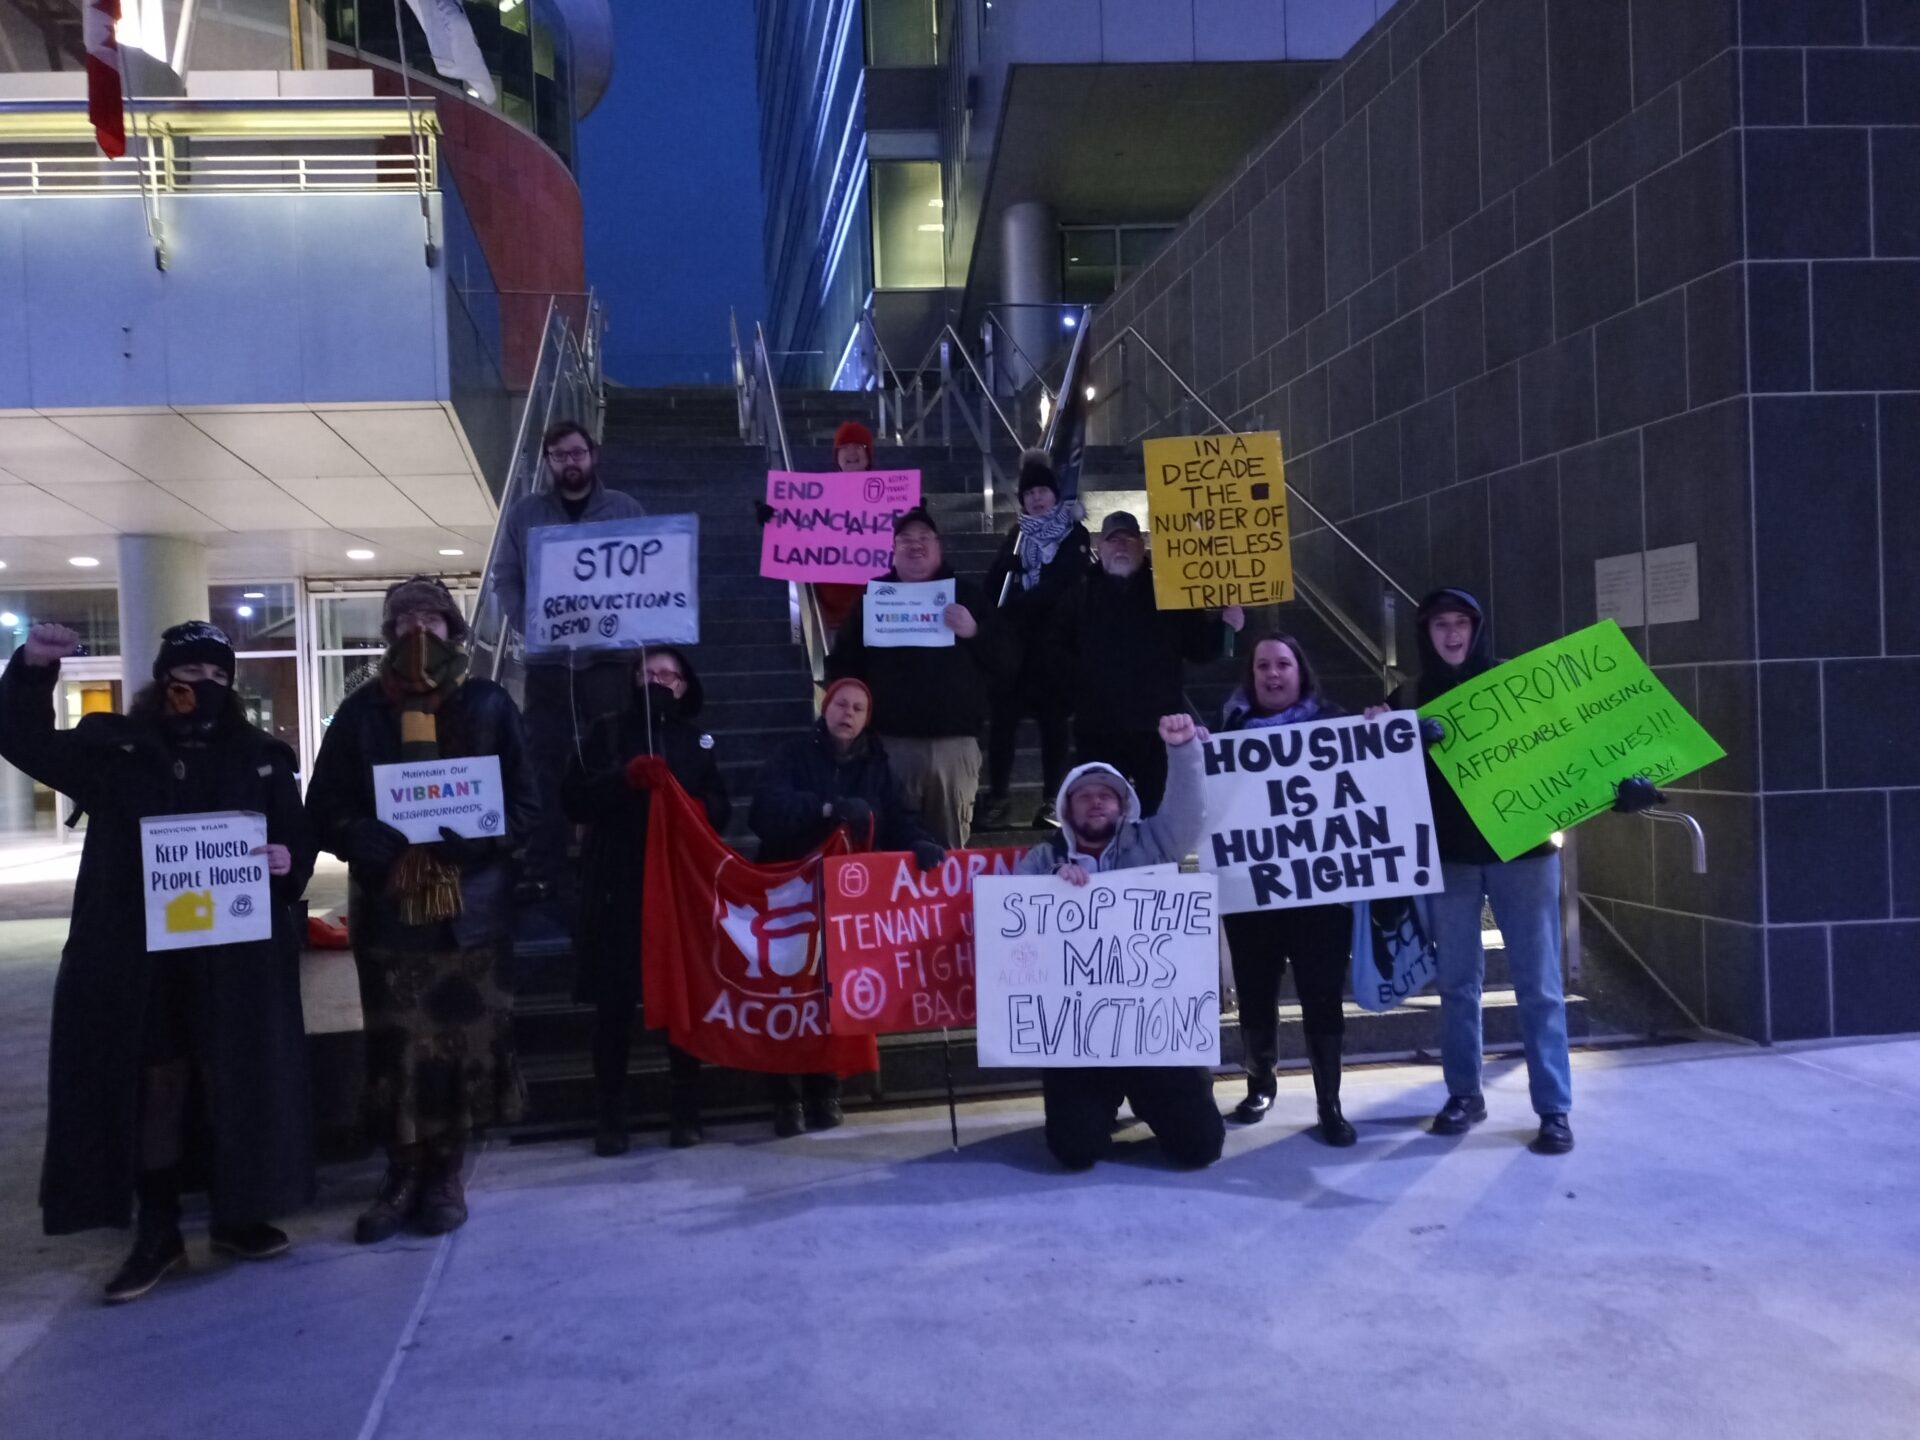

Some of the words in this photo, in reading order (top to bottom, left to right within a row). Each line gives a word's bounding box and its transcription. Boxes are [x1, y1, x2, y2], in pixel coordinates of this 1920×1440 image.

[1194, 437, 1221, 457] IN
[1231, 437, 1247, 455] A
[1162, 457, 1266, 486] DECADE
[773, 480, 824, 500] END
[1180, 483, 1242, 509] THE
[1155, 508, 1248, 535] NUMBER
[1254, 505, 1285, 527] OF
[1167, 531, 1283, 558] HOMELESS
[574, 539, 663, 581] STOP
[1182, 558, 1266, 580] COULD
[543, 591, 687, 619] RENOVICTIONS
[1180, 580, 1285, 609] TRIPLE!!!
[551, 616, 591, 641] DEMO
[875, 613, 939, 622] VIBRANT
[1427, 644, 1617, 754] DESTROYING
[1202, 718, 1416, 776] HOUSING
[1455, 717, 1575, 788] AFFORDABLE
[1577, 679, 1653, 724] HOUSING
[402, 768, 446, 780] Maintain
[450, 766, 468, 776] Our
[1491, 762, 1588, 823] RUINS
[1590, 708, 1679, 768] LIVES!!!
[390, 780, 482, 804] VIBRANT
[1266, 775, 1318, 817] IS
[1333, 770, 1366, 810] A
[392, 803, 483, 821] NEIGHBOURHOODS
[1546, 798, 1590, 829] JOIN
[1211, 806, 1391, 868] HUMAN
[830, 903, 947, 951] TENANT
[1001, 886, 1116, 938] STOP
[1124, 888, 1212, 935] THE
[894, 941, 975, 990] FIGH
[1064, 933, 1177, 988] MASS
[703, 990, 823, 1040] ACOR
[912, 985, 975, 1026] BAC
